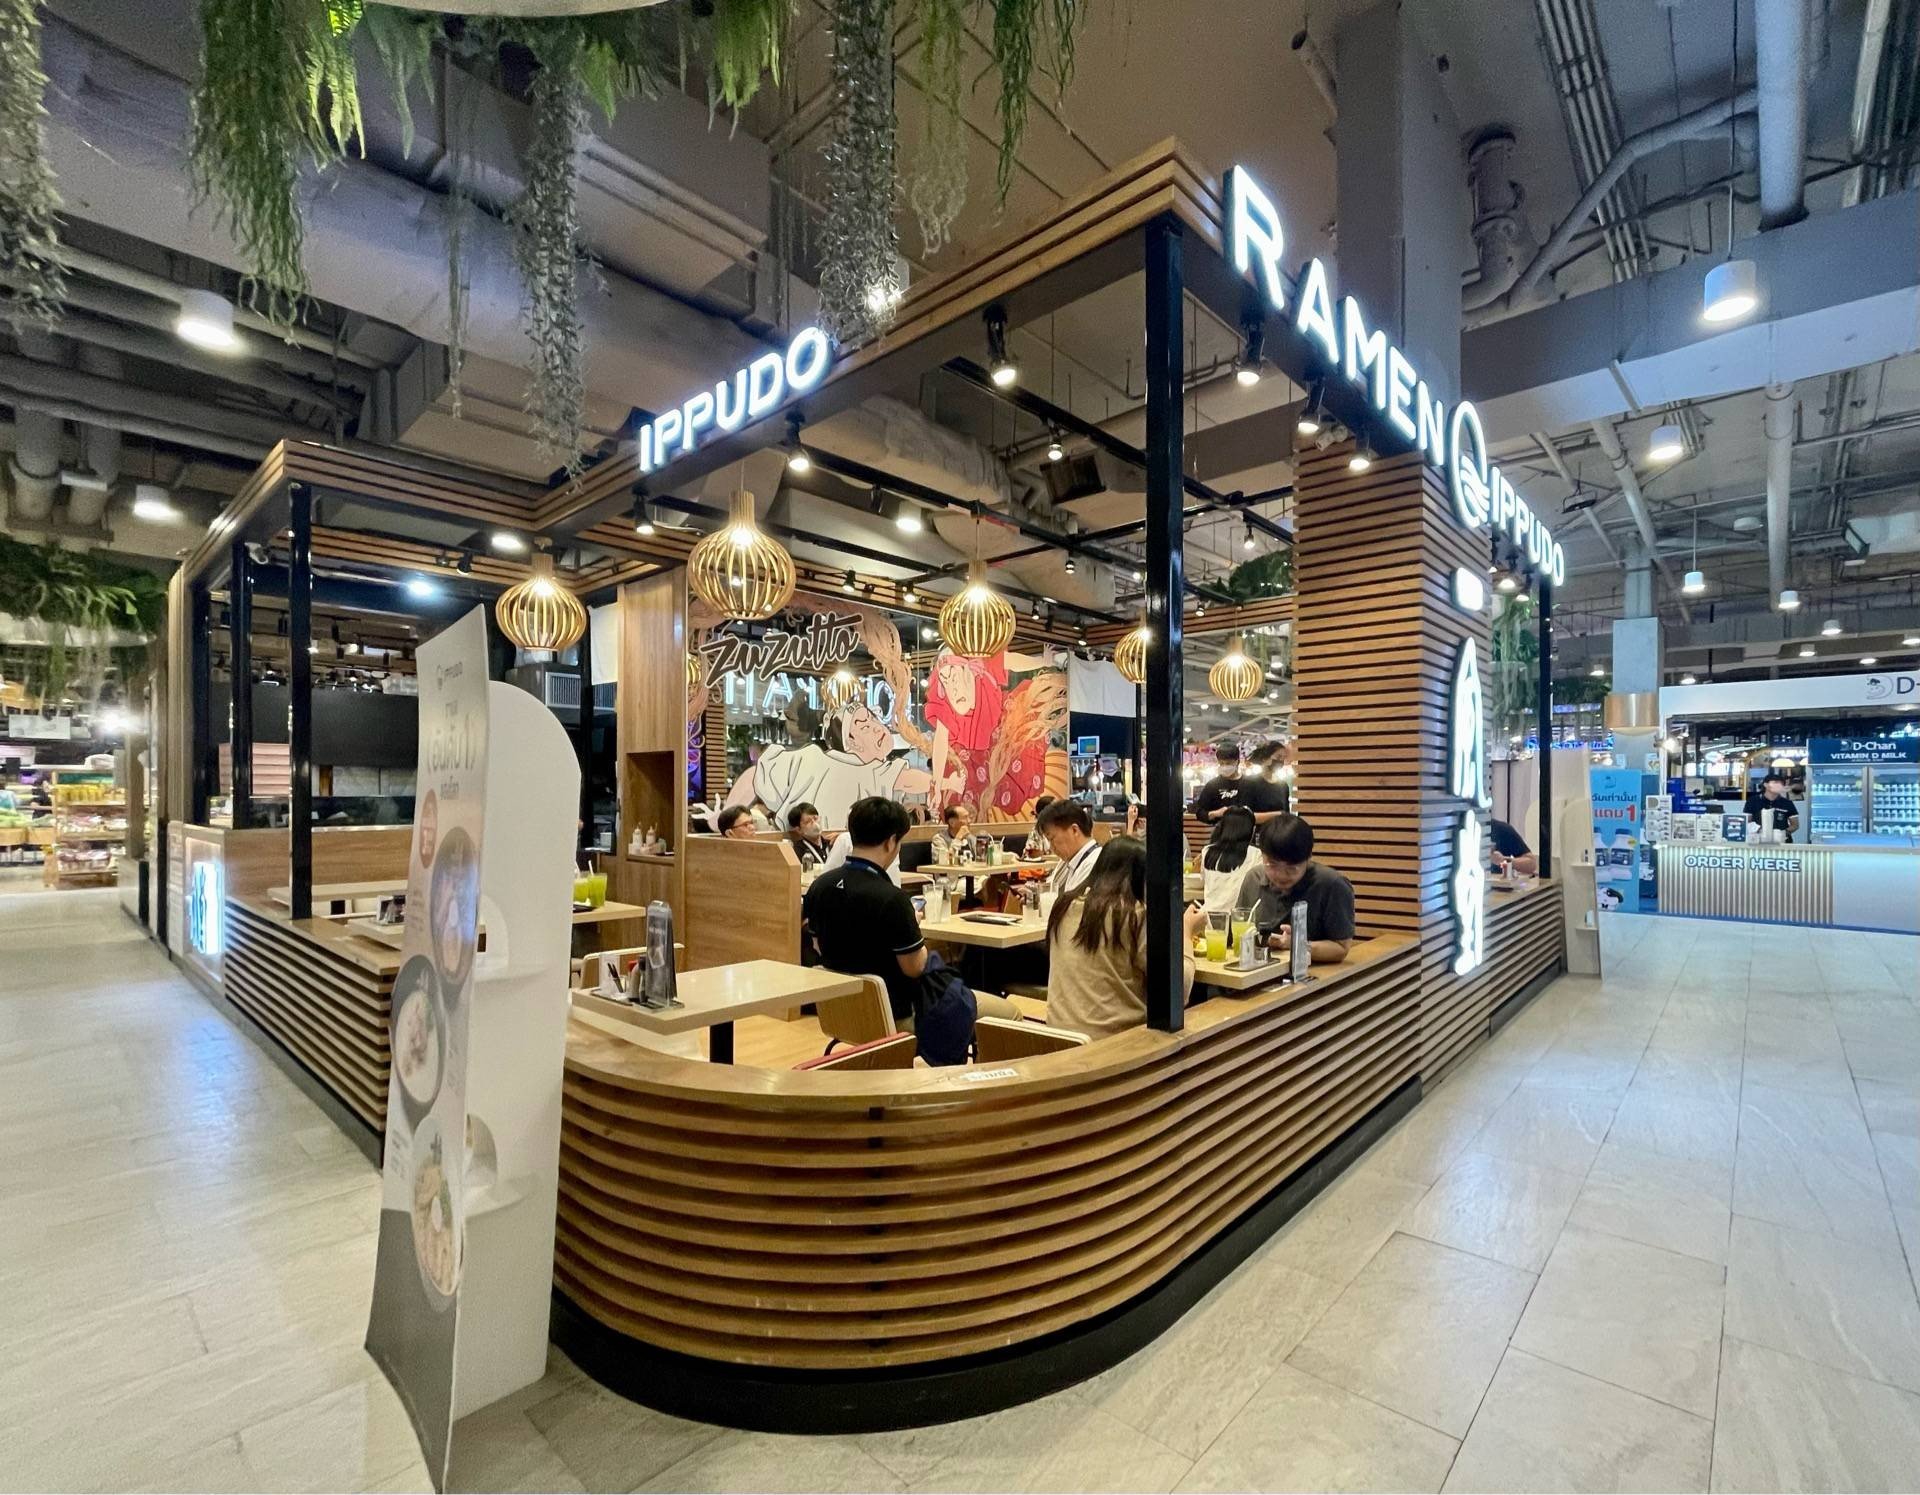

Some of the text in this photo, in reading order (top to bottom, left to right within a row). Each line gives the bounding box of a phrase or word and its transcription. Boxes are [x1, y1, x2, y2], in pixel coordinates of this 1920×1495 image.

[1233, 164, 1445, 466] RAMEN
[640, 326, 829, 472] IPPUDO
[1490, 466, 1565, 587] IPPUDO
[1852, 741, 1896, 751] D-Chan
[1831, 752, 1869, 760] VITAMIN
[1626, 804, 1636, 822] 1
[1684, 855, 1801, 873] ORDER HERE
